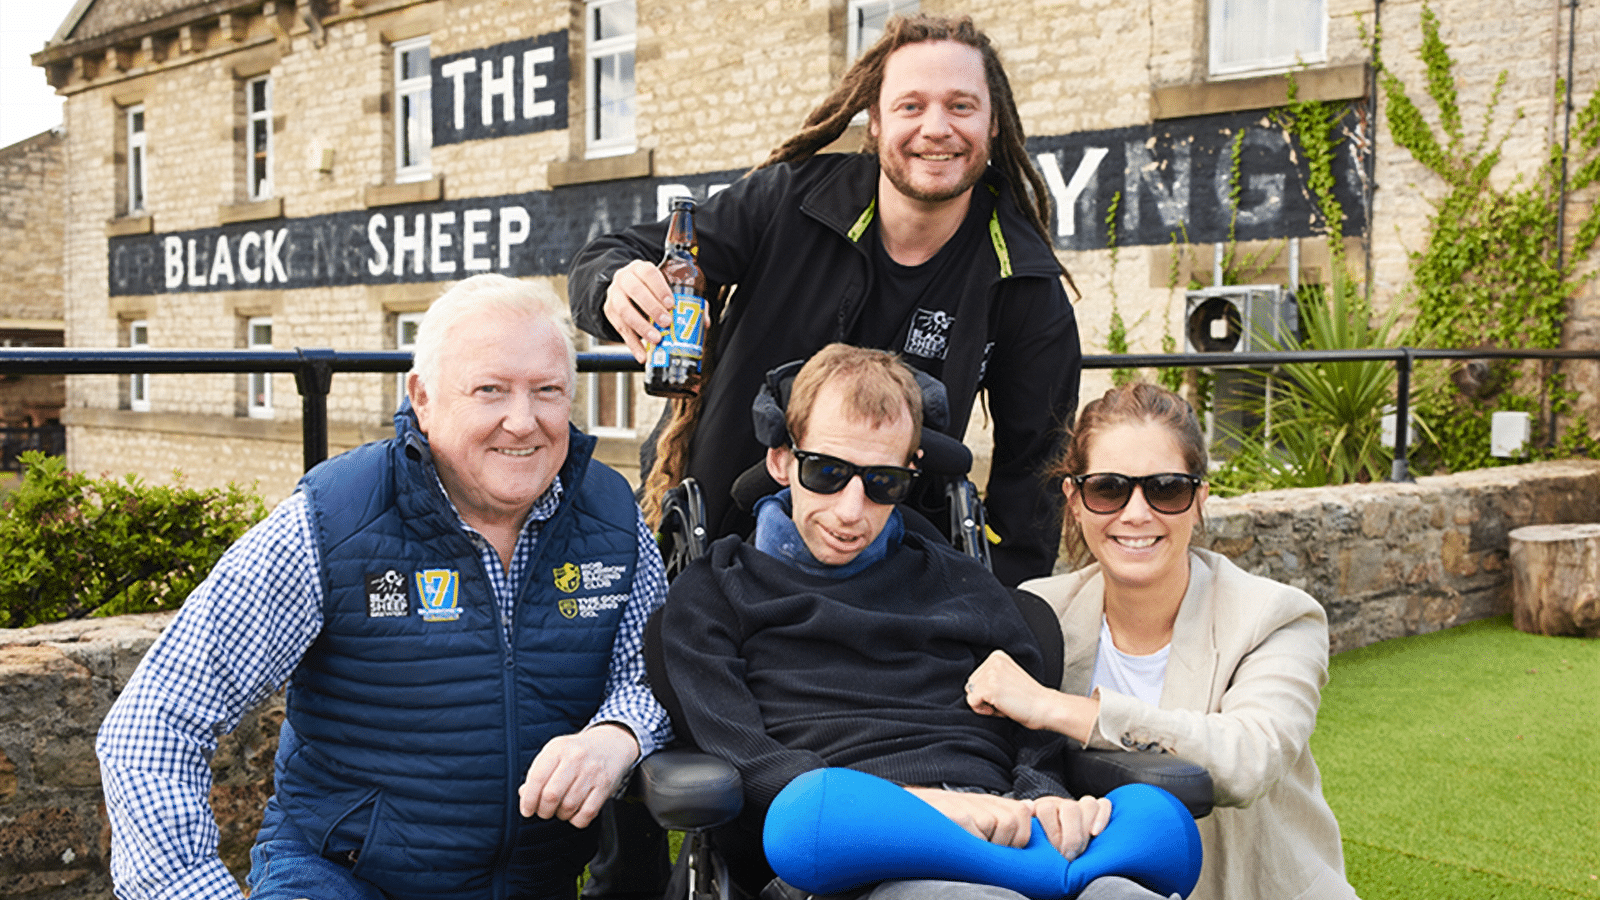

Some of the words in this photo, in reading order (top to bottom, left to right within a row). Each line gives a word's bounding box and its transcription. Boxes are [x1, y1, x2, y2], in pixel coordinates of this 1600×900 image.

[441, 46, 556, 131] THE
[165, 228, 289, 289] BLACK
[367, 206, 532, 277] SHEEP
[676, 300, 701, 340] 7
[424, 569, 451, 607] 7
